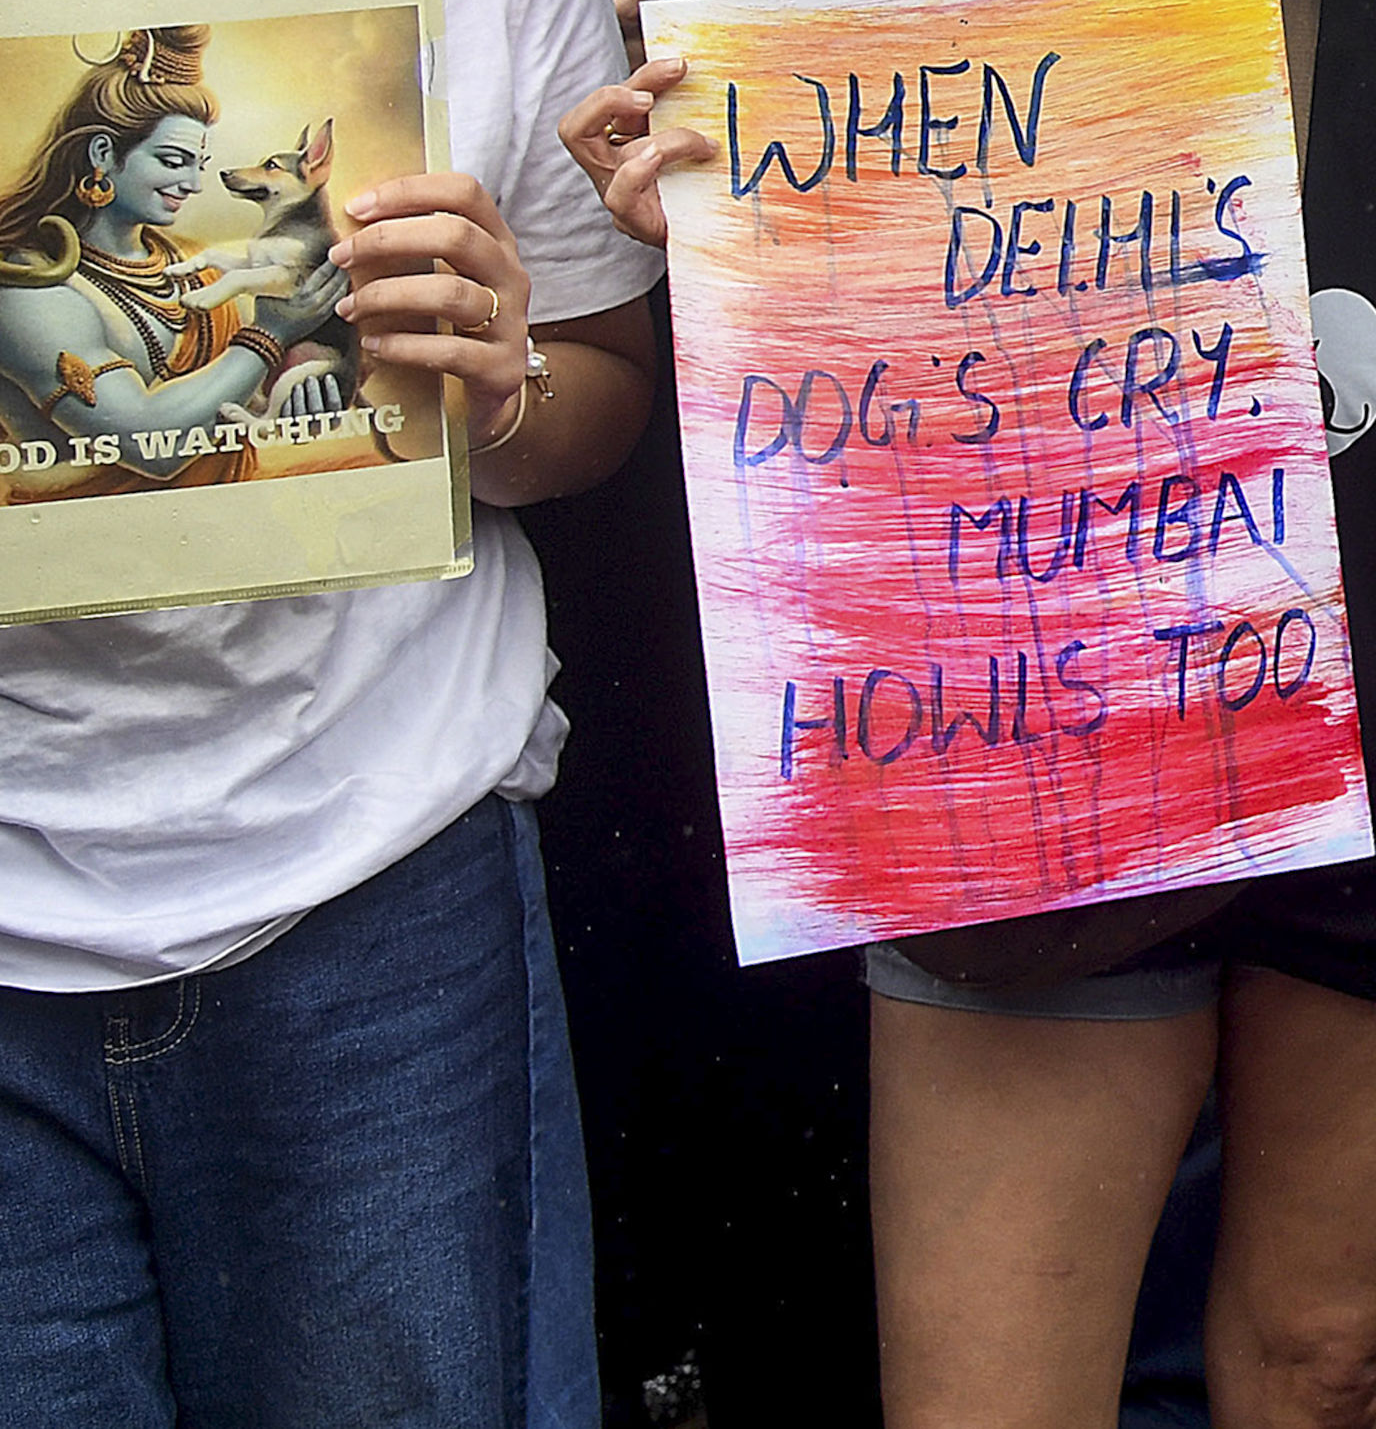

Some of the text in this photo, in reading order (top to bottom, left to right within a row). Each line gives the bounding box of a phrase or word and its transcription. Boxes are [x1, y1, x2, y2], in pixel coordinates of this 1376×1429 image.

[727, 52, 1061, 200] WHEN
[944, 176, 1264, 311] DELHI'S
[0, 403, 405, 474] OD IS WATCHING
[948, 468, 1285, 583] MUMBAI
[780, 608, 1317, 782] HOWLS TOO
